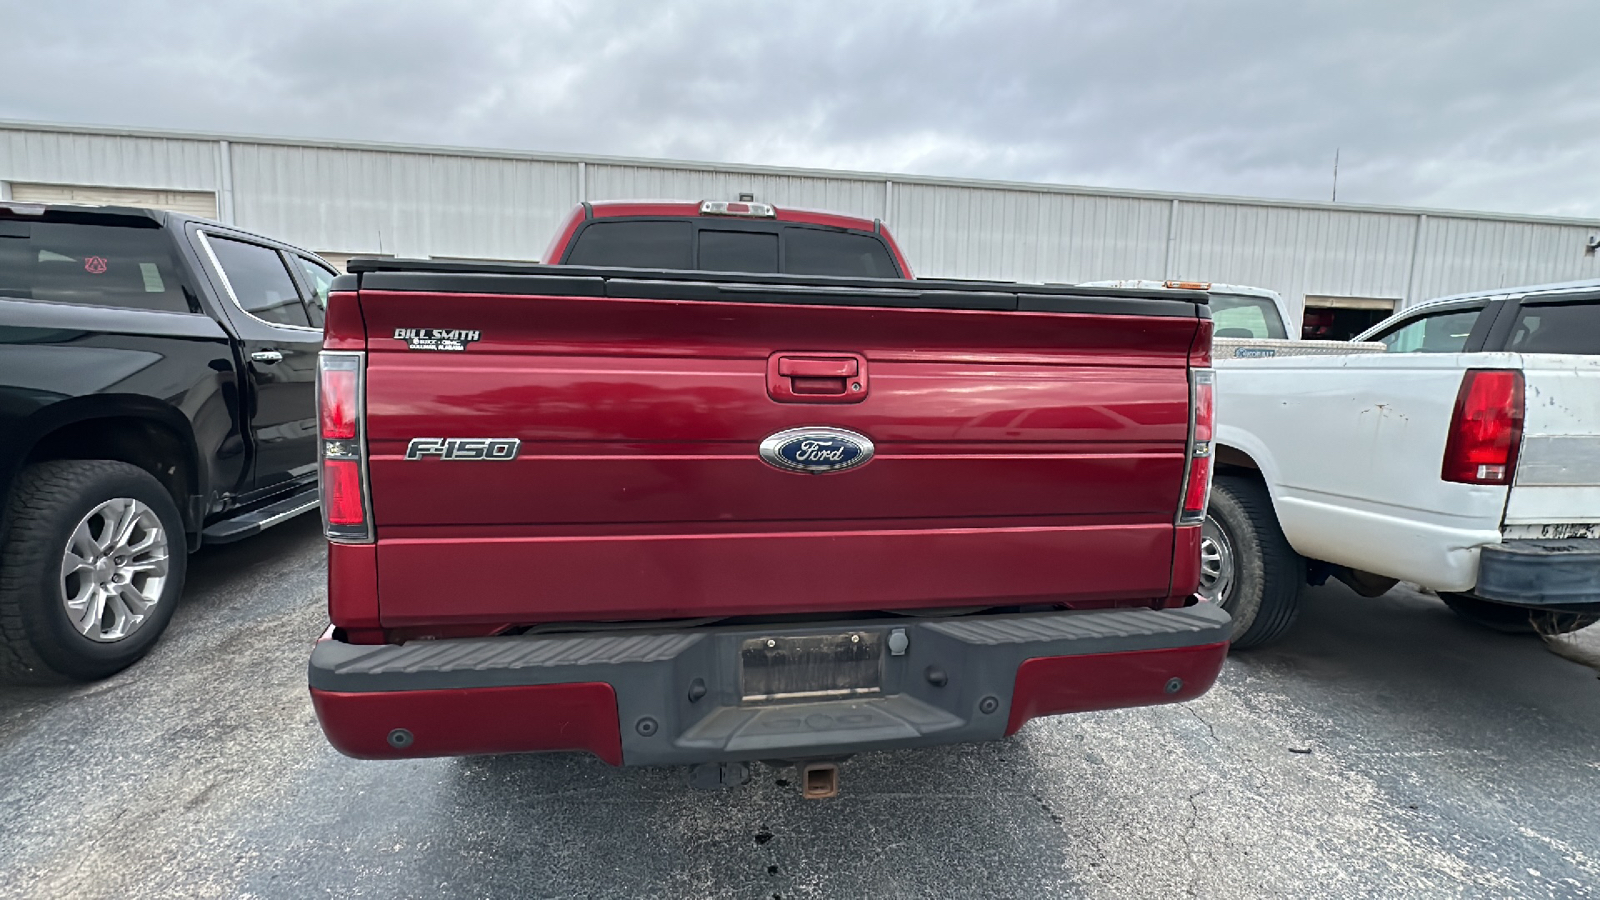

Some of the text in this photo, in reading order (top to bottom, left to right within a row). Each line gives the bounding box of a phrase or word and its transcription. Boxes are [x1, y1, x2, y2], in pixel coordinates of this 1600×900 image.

[393, 328, 480, 341] BILL SMITH
[403, 437, 520, 460] F-150
[796, 440, 845, 461] Ford
